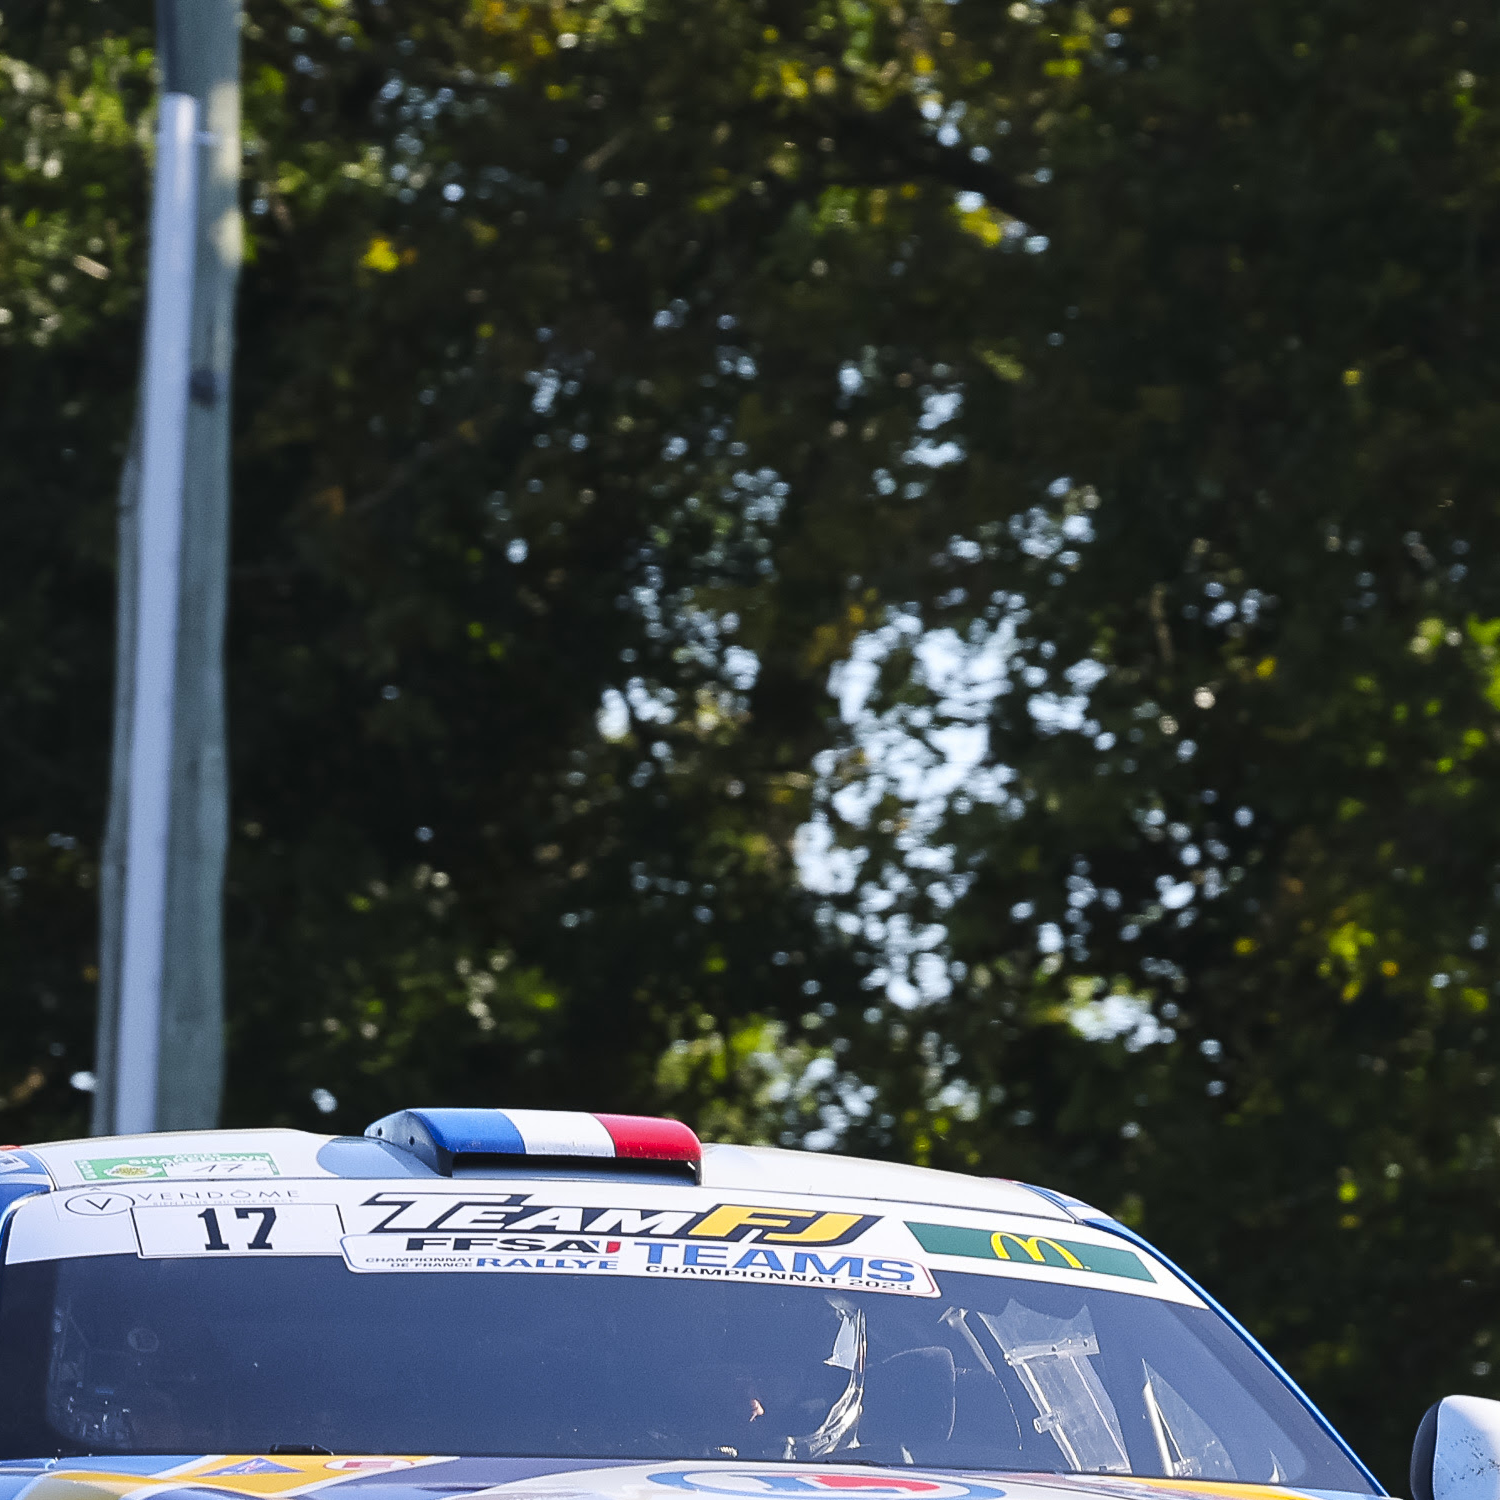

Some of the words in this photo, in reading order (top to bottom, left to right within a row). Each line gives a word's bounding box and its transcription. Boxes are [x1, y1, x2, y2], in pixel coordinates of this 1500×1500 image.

[137, 1189, 301, 1201] VENDÔME
[197, 1207, 277, 1251] 17
[406, 1237, 600, 1254] FFSA
[476, 1257, 618, 1270] RALLYE
[634, 1241, 915, 1283] TEAMS
[645, 1264, 841, 1285] CHAMPIONNAT
[849, 1279, 912, 1291] 2023
